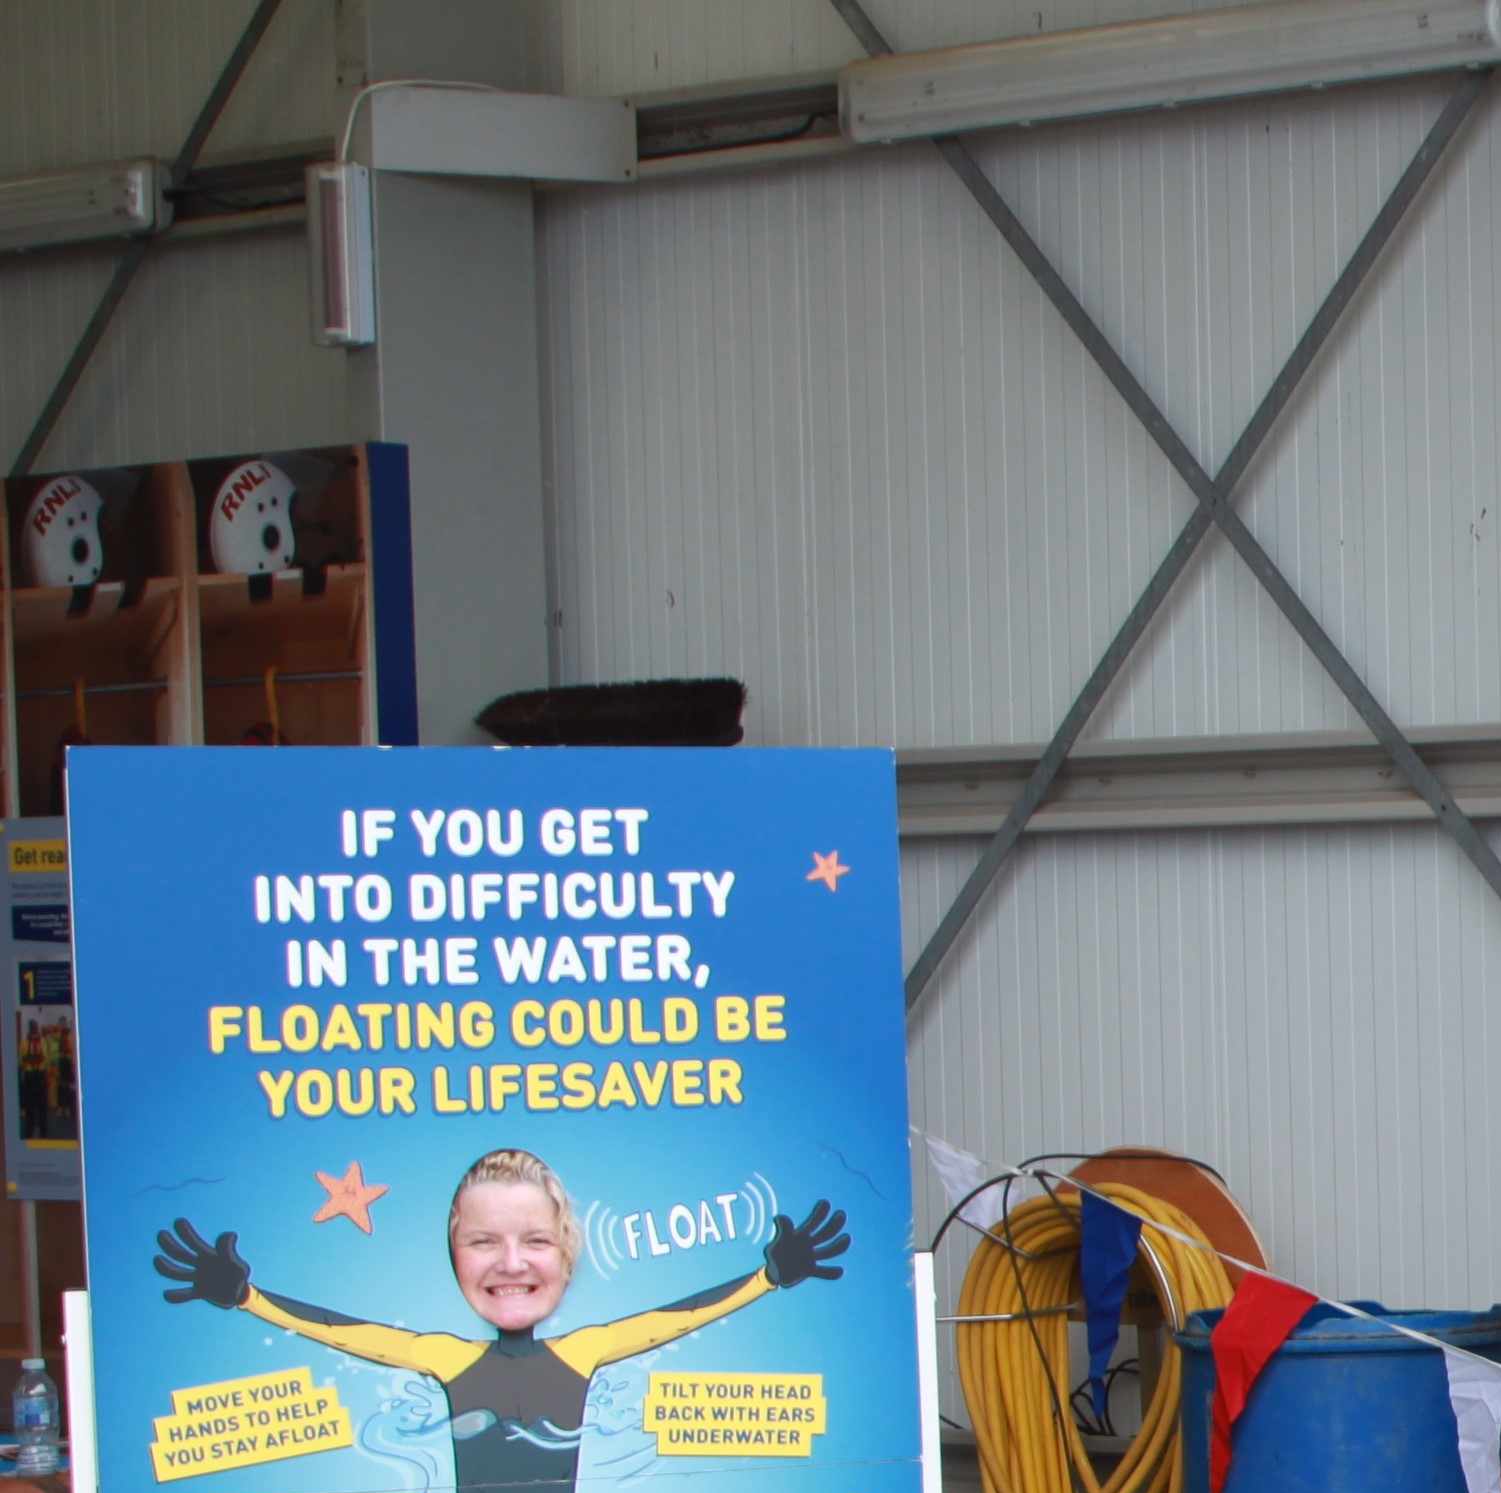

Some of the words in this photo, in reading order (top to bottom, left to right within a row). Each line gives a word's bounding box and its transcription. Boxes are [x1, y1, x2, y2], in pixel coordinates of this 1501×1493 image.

[33, 478, 82, 537] RNLI
[220, 463, 272, 523] RNLI
[14, 846, 38, 865] Get
[41, 848, 66, 864] rea
[341, 809, 396, 858] IF
[410, 808, 525, 857] YOU
[540, 808, 649, 857] GET
[254, 873, 392, 924] INTO
[409, 871, 736, 922] DIFFICULTY
[286, 939, 347, 988] IN
[362, 937, 480, 986] THE
[493, 934, 711, 990] WATER,
[208, 1000, 495, 1054] FLOATING
[511, 997, 699, 1048] COULD
[715, 994, 787, 1042] BE
[258, 1067, 416, 1118] YOUR
[433, 1058, 744, 1113] LIFESAVER
[622, 1191, 739, 1260] FLOAT
[187, 1391, 244, 1416] MOVE
[250, 1380, 303, 1402] YOUR
[655, 1405, 706, 1421] BACK
[711, 1406, 760, 1422] WITH
[766, 1407, 815, 1423] EARS
[660, 1382, 699, 1399] TILT
[705, 1383, 755, 1400] YOUR
[761, 1384, 812, 1400] HEAD
[165, 1448, 205, 1468] YOU
[211, 1437, 258, 1460] STAY
[265, 1420, 341, 1449] AFLOAT
[169, 1416, 240, 1443] HANDS
[245, 1410, 270, 1429] TO
[277, 1399, 329, 1422] HELP
[668, 1428, 801, 1445] UNDERWATER
